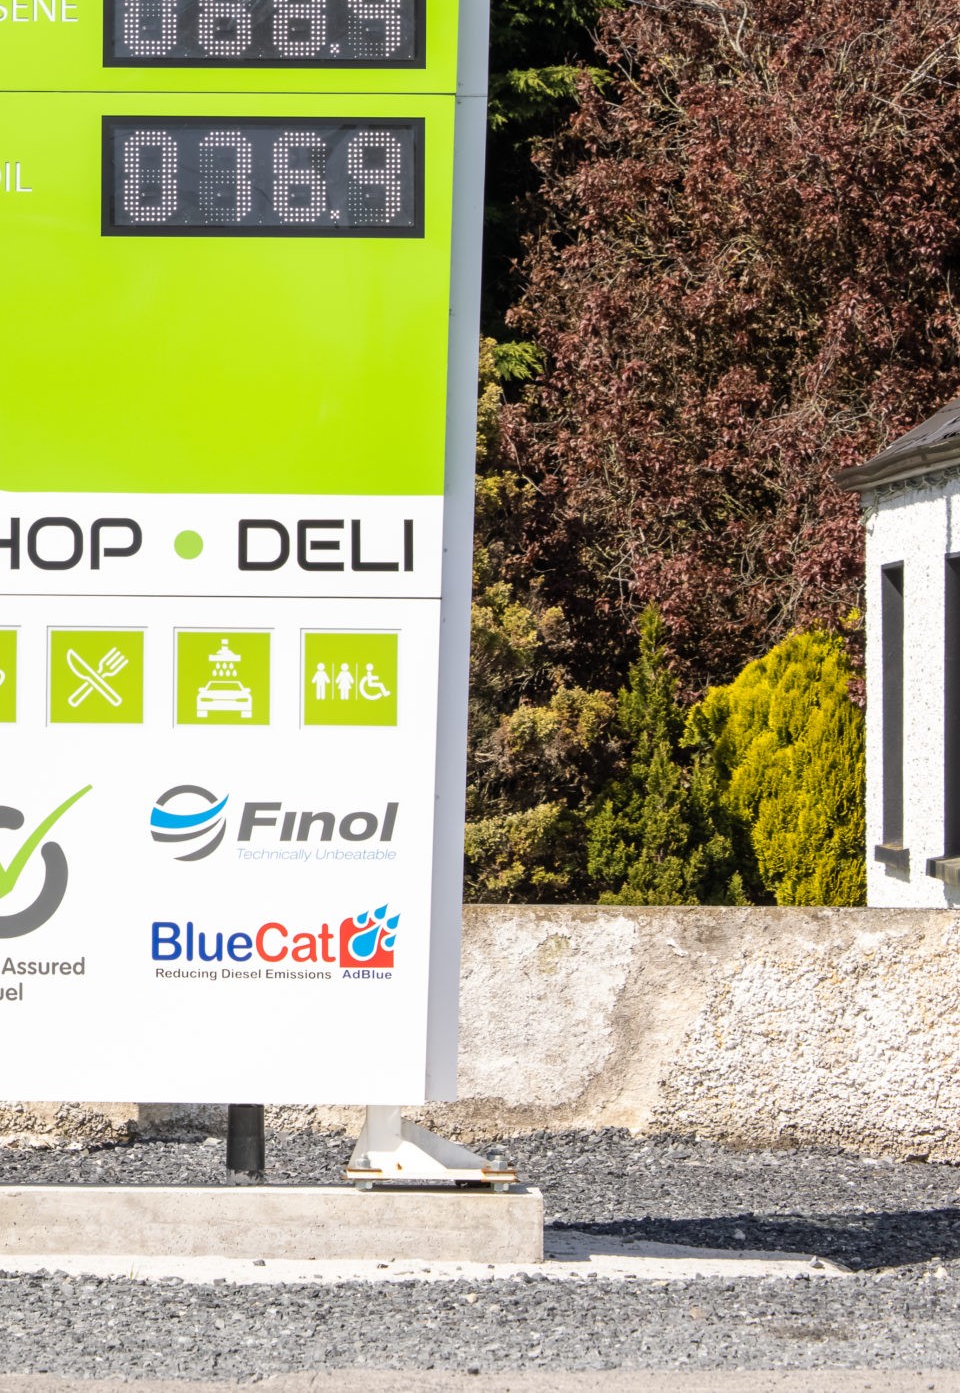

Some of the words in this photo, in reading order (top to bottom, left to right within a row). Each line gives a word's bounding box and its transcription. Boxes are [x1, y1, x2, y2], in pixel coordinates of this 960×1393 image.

[123, 130, 402, 223] 076.9
[238, 519, 414, 572] DELI
[237, 801, 400, 842] Finol
[237, 848, 312, 863] Technically
[315, 848, 397, 861] Unbeatable
[151, 921, 337, 963] BlueCat
[1, 955, 86, 977] Assured
[155, 967, 218, 982] Reducing
[221, 968, 262, 981] Diesel
[265, 969, 332, 981] Emissions
[342, 969, 393, 981] AdBlue
